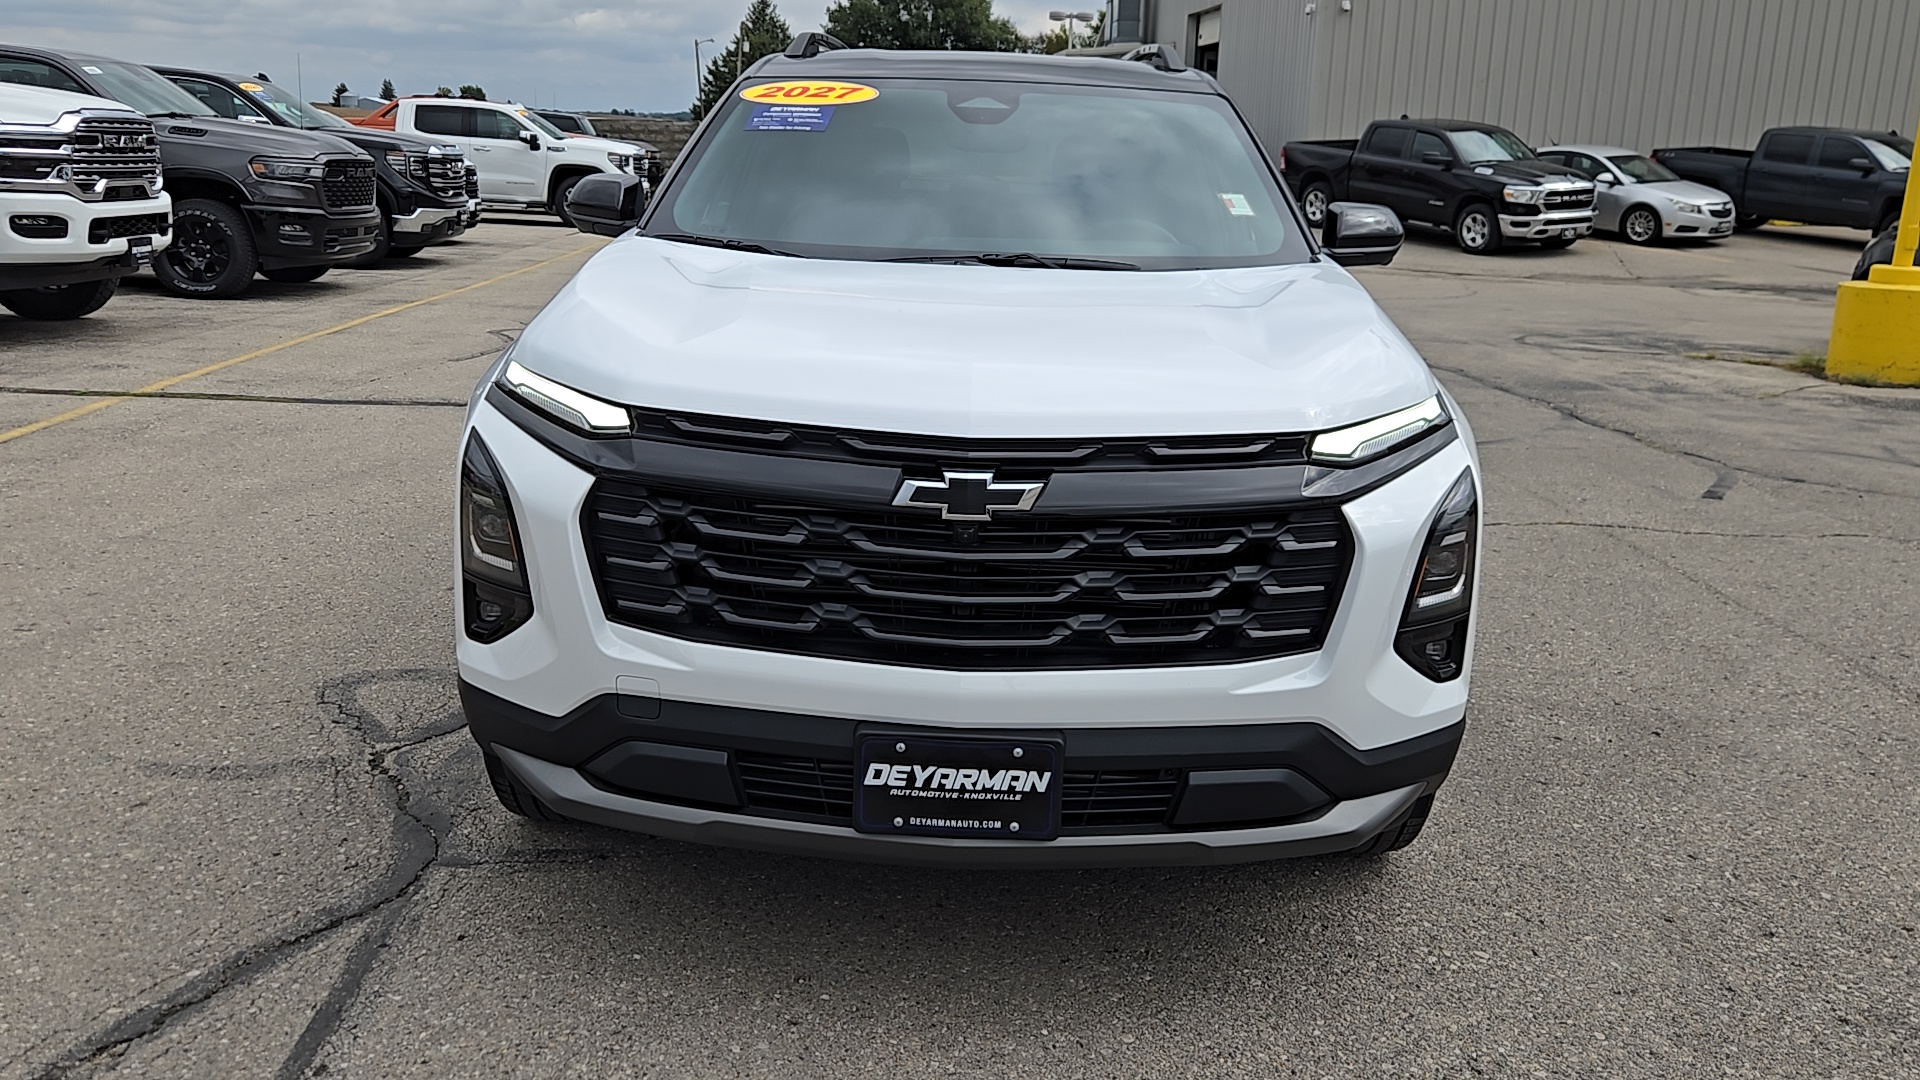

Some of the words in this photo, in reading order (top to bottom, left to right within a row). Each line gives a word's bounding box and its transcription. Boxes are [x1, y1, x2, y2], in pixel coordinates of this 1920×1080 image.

[753, 86, 865, 99] 2027
[863, 762, 1052, 793] DEYARMAN
[909, 816, 1002, 829] DEYARMANAUTO.COM
